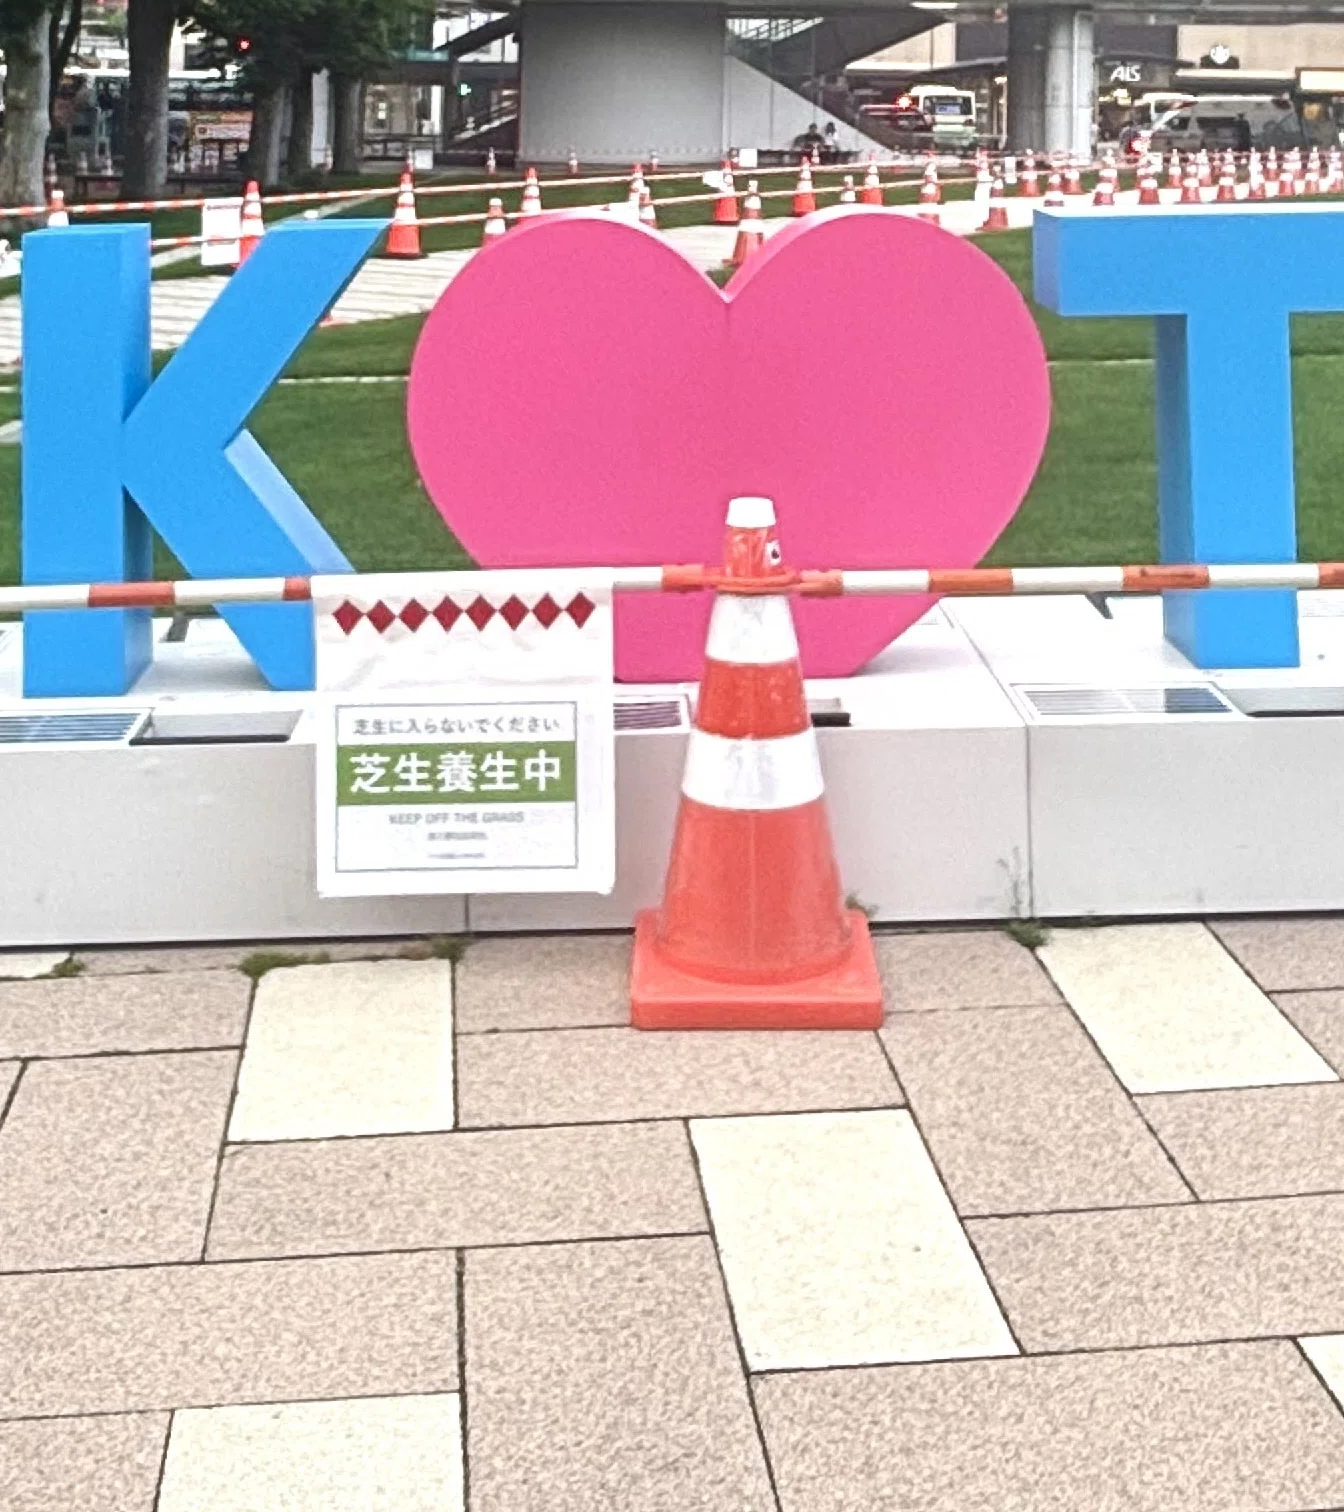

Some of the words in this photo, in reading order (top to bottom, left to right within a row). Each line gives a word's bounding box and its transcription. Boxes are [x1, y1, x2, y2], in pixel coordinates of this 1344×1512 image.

[352, 716, 560, 736] 芝生に入らないでください
[348, 748, 561, 794] 芝生養生中
[388, 813, 422, 825] KEEP
[425, 813, 449, 825] OFF
[454, 811, 478, 824] THE
[482, 811, 524, 824] GRASS
